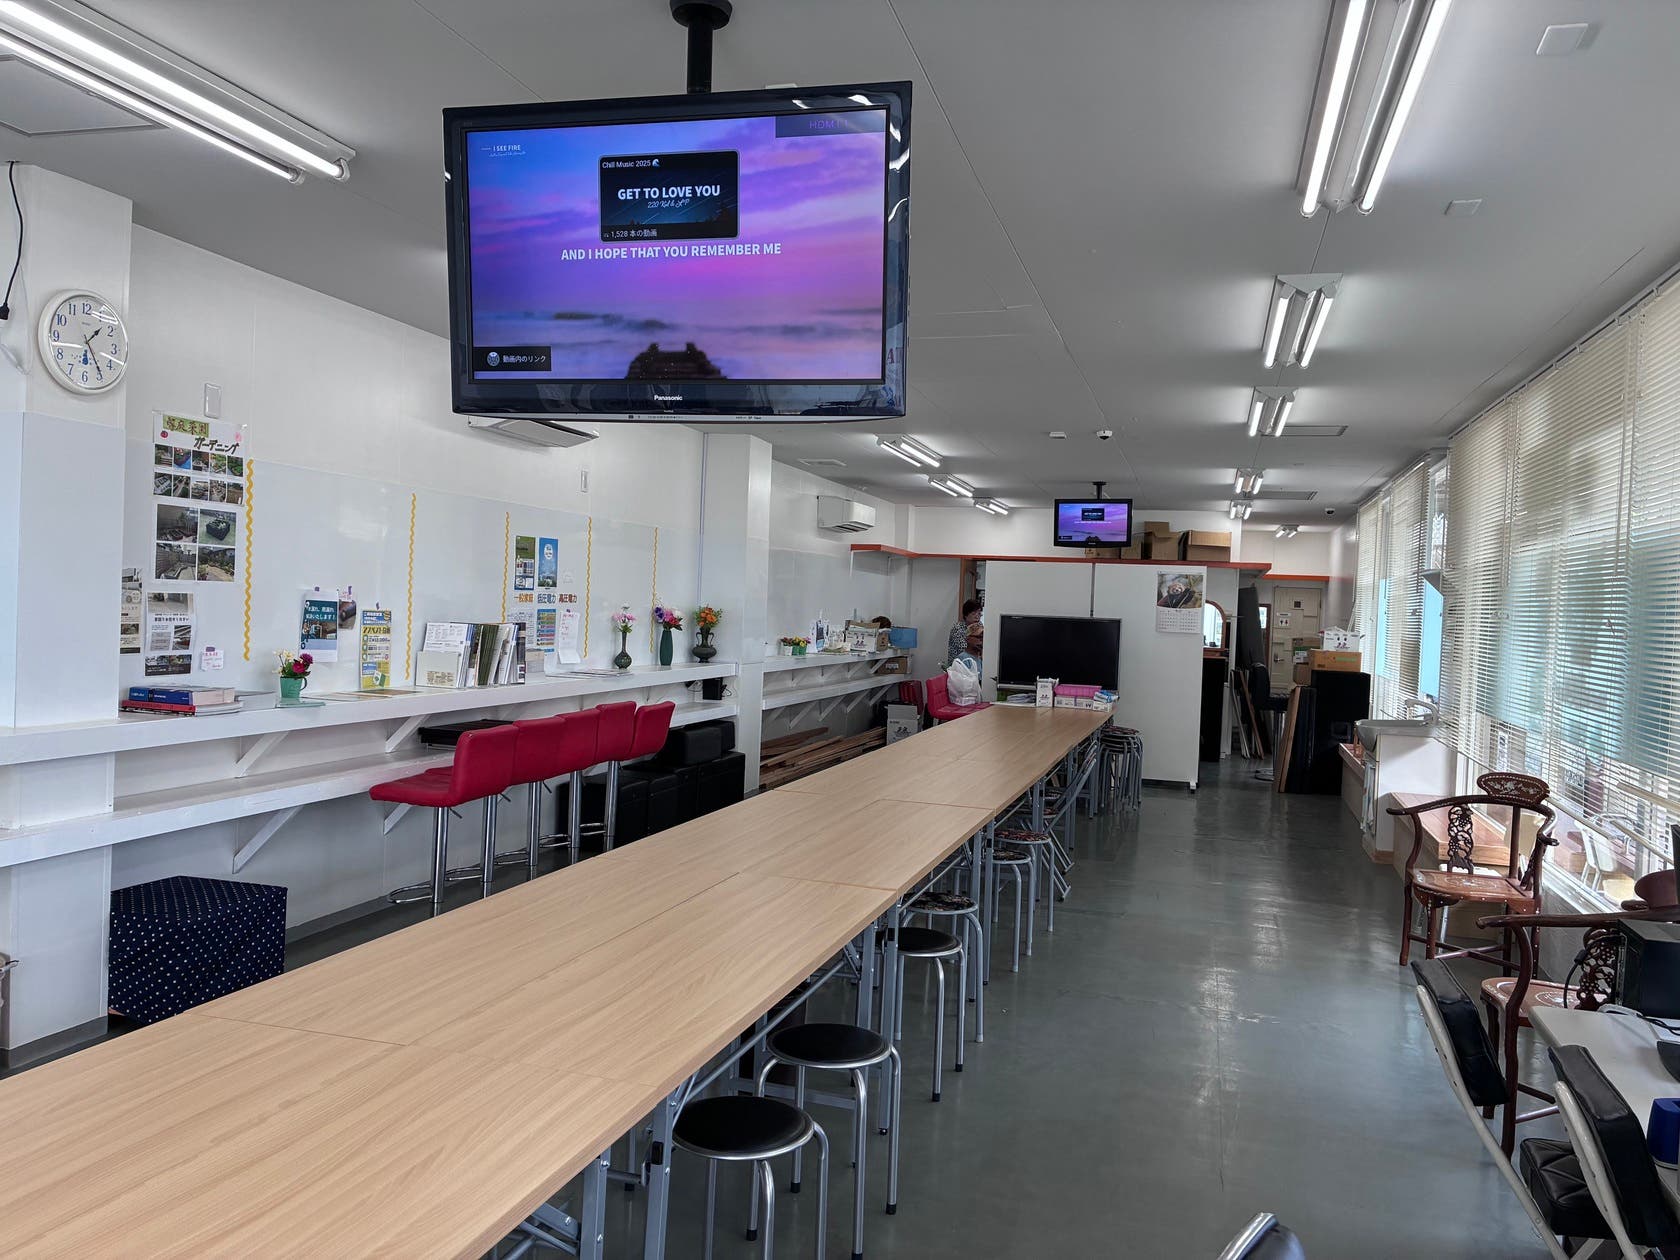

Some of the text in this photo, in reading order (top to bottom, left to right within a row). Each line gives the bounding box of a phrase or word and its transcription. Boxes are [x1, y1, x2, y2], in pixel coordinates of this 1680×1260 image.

[616, 160, 634, 168] Music
[618, 185, 720, 200] GET TO LOVE YOU
[629, 229, 657, 237] 本の動画
[561, 243, 781, 260] AND I HOPE THAT YOU REMEMBER ME
[68, 303, 76, 316] 11
[82, 302, 92, 315] 12
[56, 314, 67, 326] 10
[53, 330, 60, 342] 9
[107, 325, 114, 337] 2
[56, 348, 64, 360] 8
[110, 343, 118, 355] 3
[106, 359, 113, 371] 4
[502, 355, 546, 363] 動画内のリンク
[67, 363, 74, 375] 7
[81, 370, 88, 383] 6
[194, 437, 240, 455] ガーデニング
